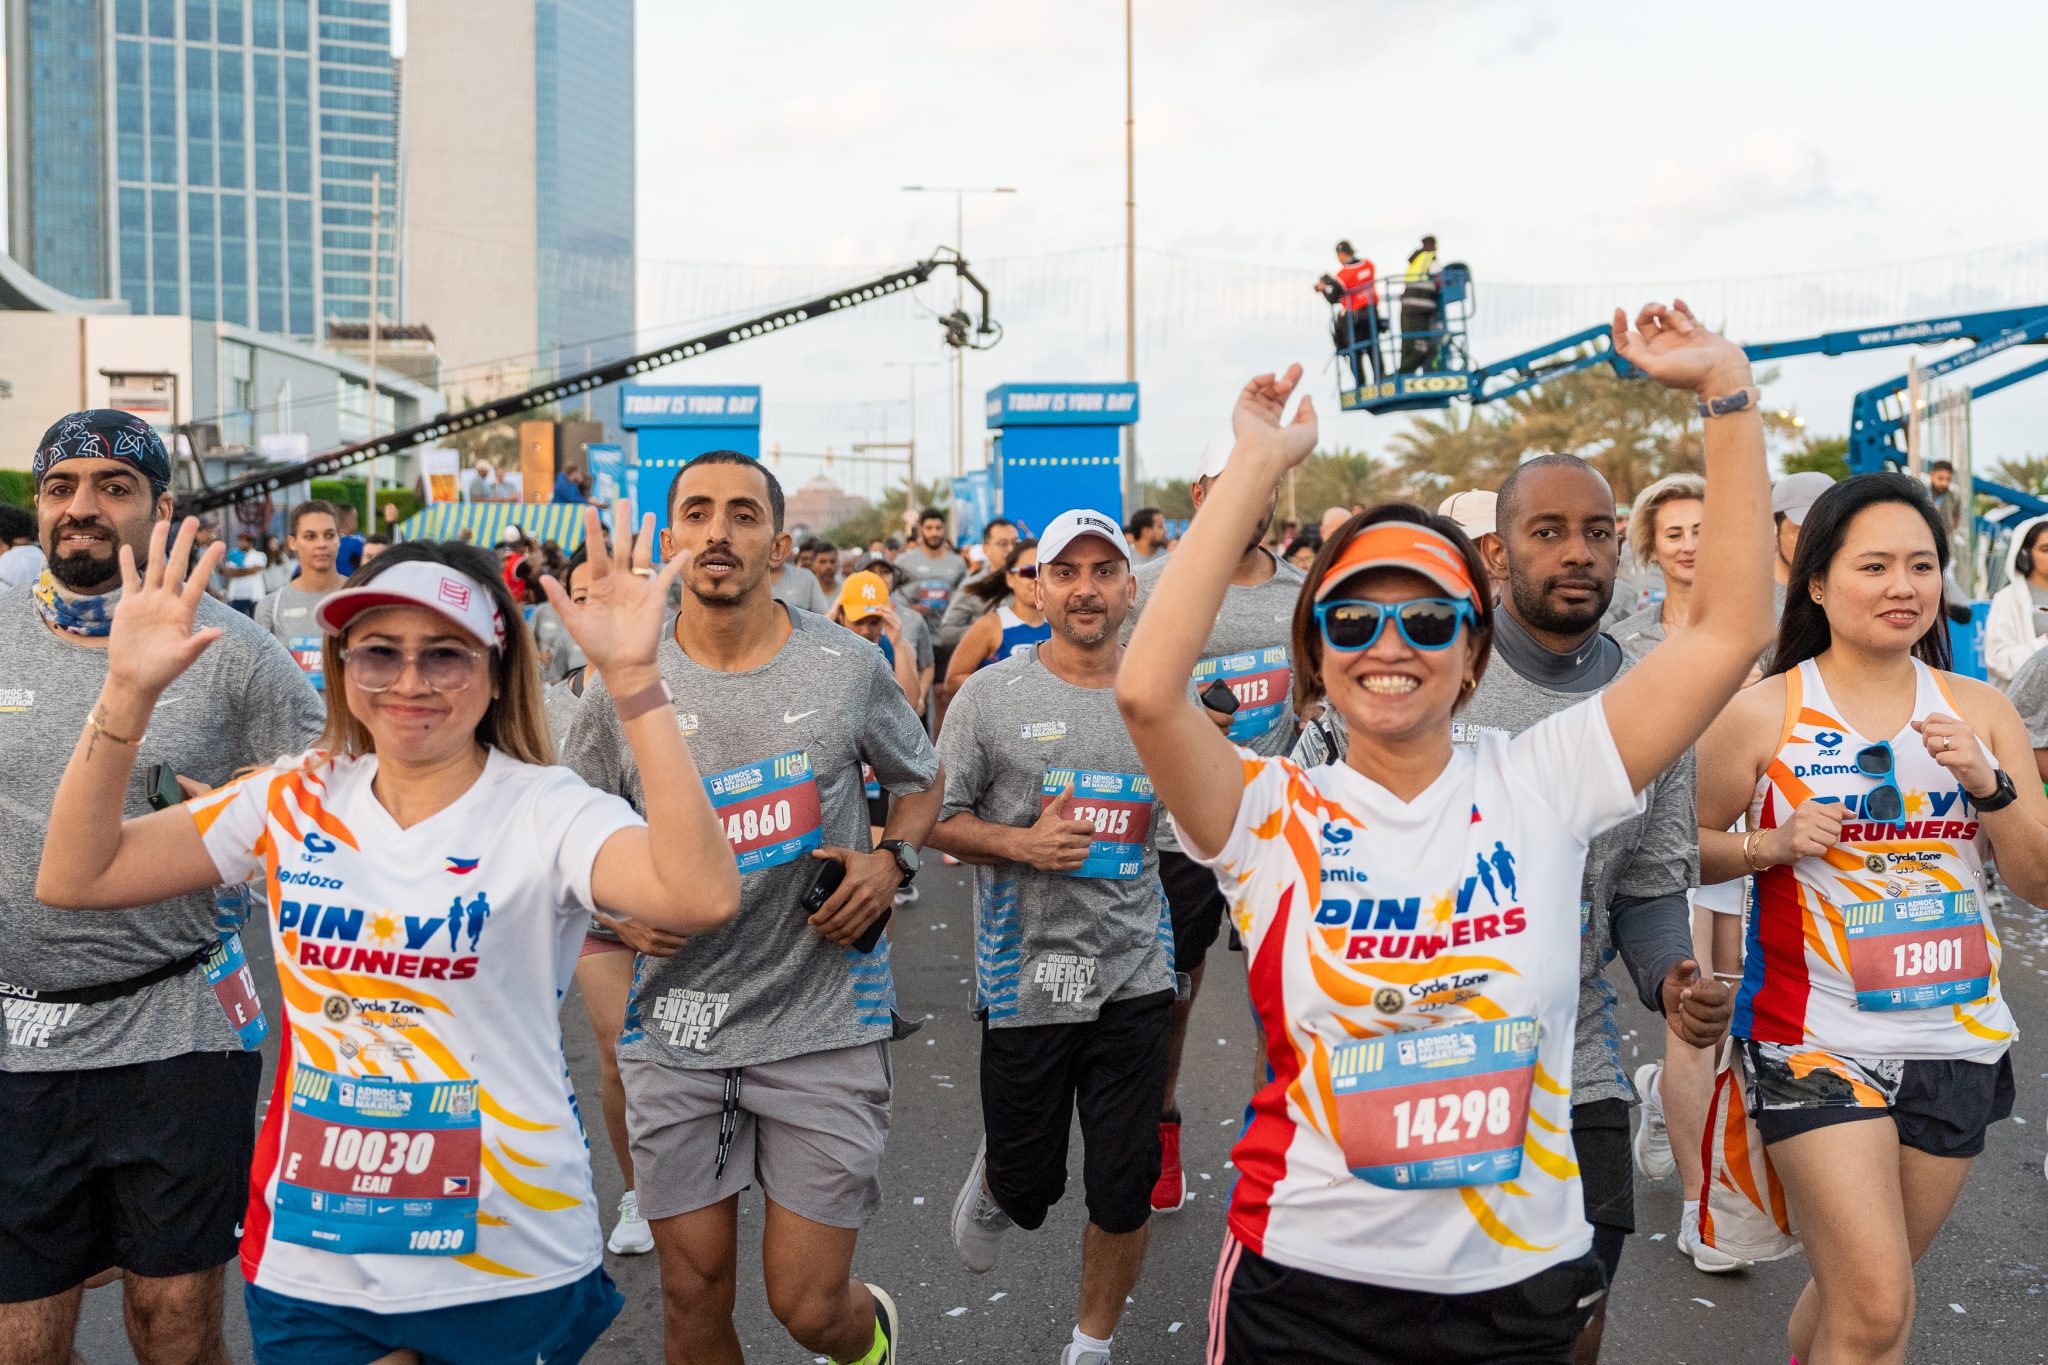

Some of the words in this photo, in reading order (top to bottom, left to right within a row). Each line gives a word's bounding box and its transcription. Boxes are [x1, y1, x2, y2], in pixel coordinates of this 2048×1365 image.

[625, 395, 671, 414] TODAY
[670, 395, 686, 414] IS
[688, 395, 726, 414] YOUR
[727, 395, 759, 414] DAY
[1008, 393, 1053, 411] TODAY
[1051, 393, 1068, 411] IS
[1068, 393, 1105, 411] YOUR
[1105, 393, 1136, 411] DAY
[1228, 678, 1269, 705] 4113
[1032, 721, 1057, 730] ADNOC
[1032, 729, 1067, 738] MARATHON
[724, 769, 751, 783] ADNOC
[725, 776, 762, 792] MARATHON
[1091, 782, 1122, 790] MARATHON
[1073, 806, 1132, 835] 13815
[1840, 821, 1979, 842] RUNNERS
[1887, 852, 1917, 864] Cycle
[1916, 852, 1942, 861] Zone
[1119, 862, 1140, 875] 13815
[1908, 898, 1934, 908] ADNOC
[1909, 908, 1945, 918] MARATHON
[1346, 907, 1527, 960] RUNNERS
[300, 942, 480, 981] RUNNERS
[1047, 953, 1078, 964] DISCOVER
[1079, 956, 1095, 966] YOUR
[1894, 937, 1963, 978] 13801
[1033, 962, 1096, 985] ENERGY
[0, 981, 38, 999] 2XU
[667, 988, 705, 1003] DISCOVER
[706, 992, 730, 1003] YOUR
[1041, 983, 1054, 992] FOR
[1052, 982, 1086, 1003] LIFE
[1409, 977, 1449, 999] Cycle
[1451, 974, 1489, 989] Zone
[2, 997, 81, 1027] ENERGY
[234, 1002, 247, 1025] E
[351, 997, 387, 1013] Cycle
[652, 996, 730, 1028] ENERGY
[11, 1018, 58, 1048] LIFE
[659, 1019, 676, 1032] FOR
[668, 1021, 711, 1050] LIFE
[1417, 1033, 1458, 1048] ADNOC
[1418, 1046, 1476, 1062] MARATHON
[357, 1085, 397, 1099] ADNOC
[355, 1097, 411, 1112] MARATHON
[1393, 1086, 1511, 1149] 14298
[320, 1126, 436, 1176] 10030
[284, 1152, 302, 1181] E
[352, 1174, 393, 1194] LEAH
[408, 1228, 465, 1250] 10030
